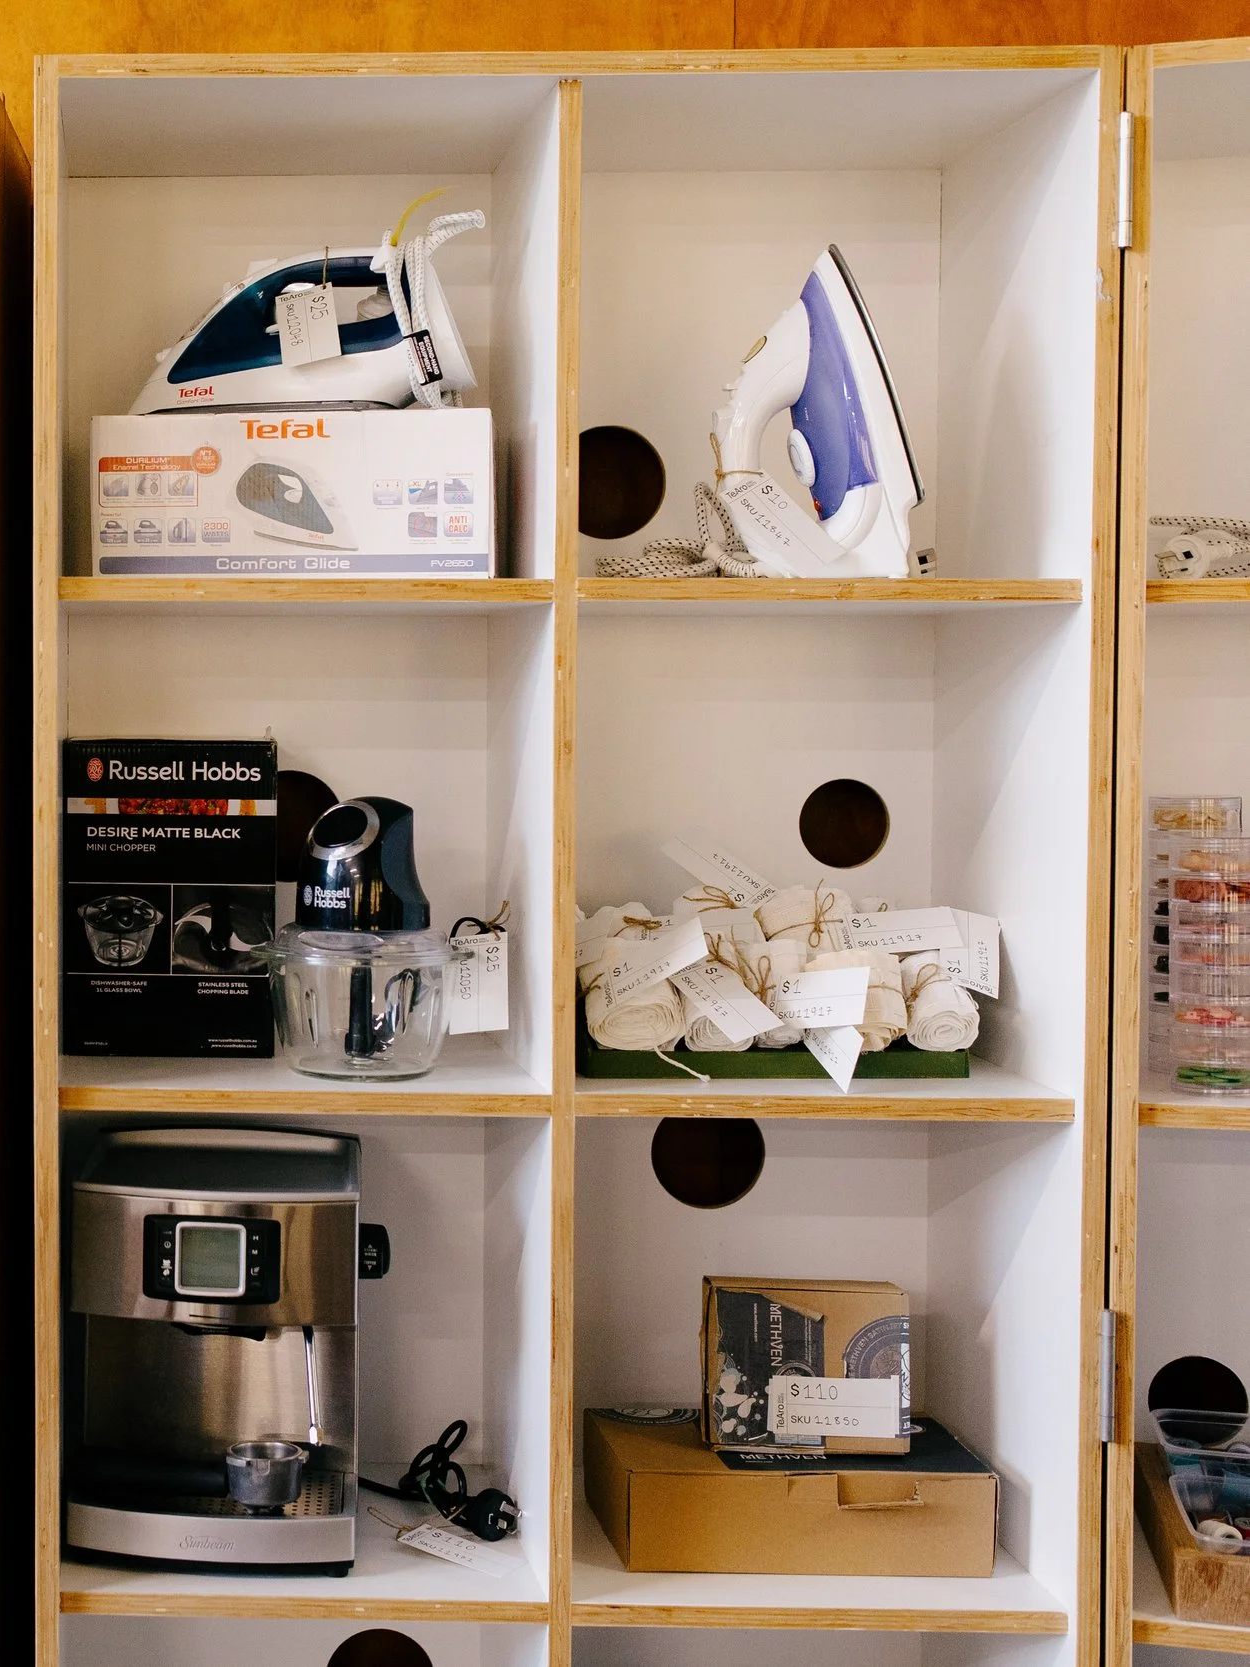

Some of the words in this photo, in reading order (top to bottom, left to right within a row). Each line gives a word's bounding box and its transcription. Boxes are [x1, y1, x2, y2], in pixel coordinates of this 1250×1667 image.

[279, 292, 303, 303] TeAro
[286, 303, 295, 316] SKU
[310, 295, 329, 320] $25
[179, 386, 215, 398] Tefal
[240, 418, 331, 440] Tefal
[141, 464, 181, 472] Technology
[725, 484, 748, 499] TeAro
[761, 485, 788, 510] $10
[203, 522, 229, 530] 2300
[448, 515, 468, 523] ANTI
[740, 498, 758, 515] SKU
[754, 514, 791, 547] 11847
[448, 524, 468, 533] CALC
[216, 557, 297, 570] Comfort
[304, 557, 351, 569] Glide
[109, 760, 185, 781] Russell
[192, 761, 261, 782] Hobbs
[87, 826, 139, 840] DESIRE
[142, 827, 191, 838] MATTE
[194, 828, 241, 839] BLACK
[86, 843, 107, 851] MINI
[109, 843, 156, 852] CHOPPER
[712, 853, 744, 877] 11917
[743, 875, 760, 889] SKU
[314, 886, 351, 899] Russell
[727, 885, 745, 903] $1
[314, 896, 347, 909] Hobbs
[851, 918, 877, 929] $1
[454, 938, 478, 946] TeAro
[858, 940, 878, 948] SKU
[880, 934, 923, 946] 11917
[486, 946, 500, 973] $25
[947, 959, 963, 974] $1
[613, 962, 633, 977] $1
[705, 966, 724, 985] $1
[980, 967, 989, 982] SKU
[617, 984, 635, 996] SKU
[636, 961, 671, 986] 11917
[782, 979, 802, 994] $1
[969, 980, 995, 995] TeAro
[681, 976, 698, 990] SKU
[695, 988, 728, 1017] 11917
[778, 1011, 795, 1020] SKU
[797, 1006, 833, 1019] 11917
[770, 1303, 783, 1367] METHVEN
[790, 1383, 838, 1401] $110
[776, 1404, 785, 1429] TeAro
[790, 1415, 811, 1424] SKU
[815, 1415, 859, 1427] 11850
[179, 1534, 235, 1551] Sunbeam
[418, 1540, 436, 1549] SKU
[432, 1532, 477, 1551] $110
